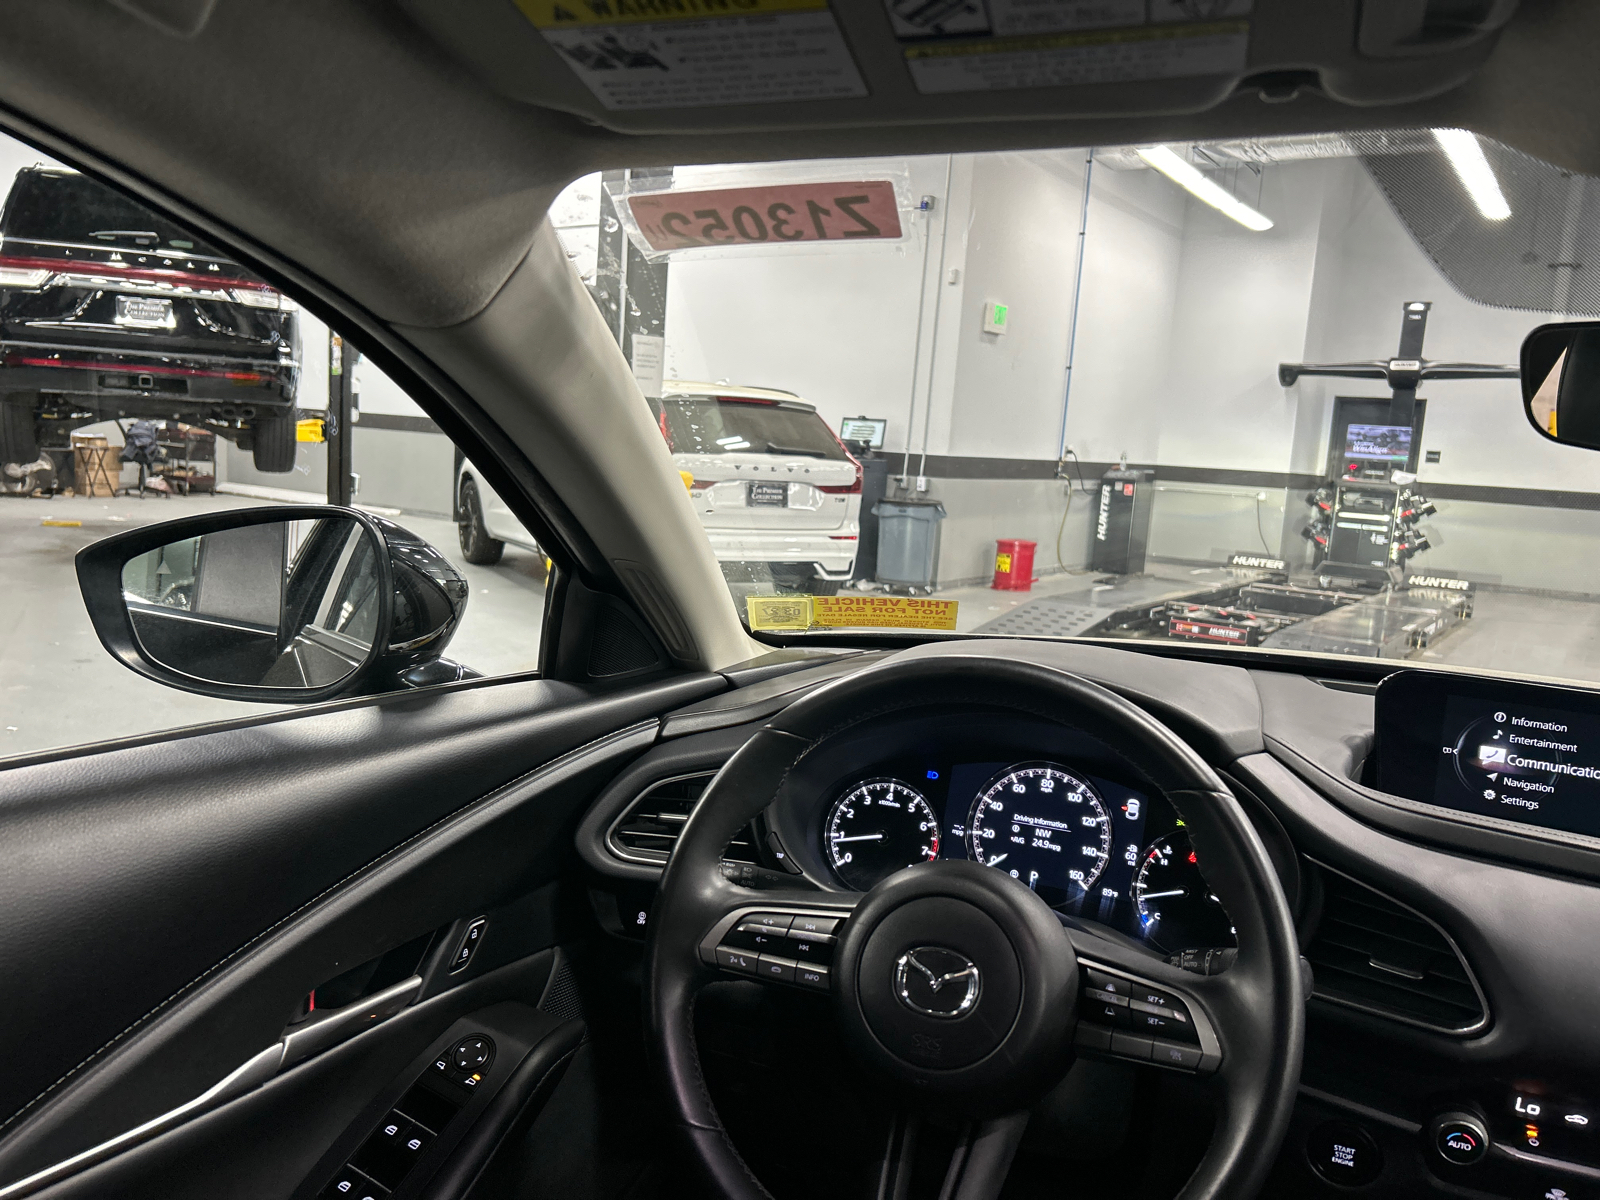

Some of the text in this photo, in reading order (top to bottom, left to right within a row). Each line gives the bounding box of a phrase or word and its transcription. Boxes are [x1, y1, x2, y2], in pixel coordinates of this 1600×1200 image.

[734, 464, 811, 474] VOLVO
[1096, 484, 1111, 541] HUNTER
[1232, 555, 1285, 570] HUNTER
[1408, 575, 1470, 591] HUNTER
[1208, 627, 1241, 639] HUNTER
[1511, 716, 1568, 733] Information
[1509, 734, 1578, 753] Entertainment
[1012, 784, 1026, 794] 60
[1041, 779, 1054, 788] 80
[1503, 776, 1555, 794] Navigation
[863, 795, 871, 805] 3
[886, 792, 894, 801] 4
[1067, 792, 1082, 803] 100
[1500, 794, 1540, 810] Settings
[908, 802, 916, 813] 5
[990, 801, 1003, 811] 40
[846, 808, 854, 818] 2
[920, 821, 928, 831] 6
[1013, 813, 1068, 829] Driving Information
[1082, 816, 1096, 827] 120
[982, 828, 996, 839] 20
[1035, 828, 1052, 838] NW
[921, 846, 929, 855] 7
[1082, 846, 1097, 857] 140
[1125, 851, 1137, 860] 60
[844, 852, 852, 863] 0
[1030, 870, 1039, 882] P
[1069, 869, 1084, 880] 160
[740, 879, 755, 887] AUTO
[804, 973, 820, 982] INFO
[1333, 1144, 1356, 1155] START
[1447, 1139, 1472, 1151] AUTO
[1335, 1151, 1354, 1160] STOP
[1331, 1156, 1355, 1167] ENGINE
